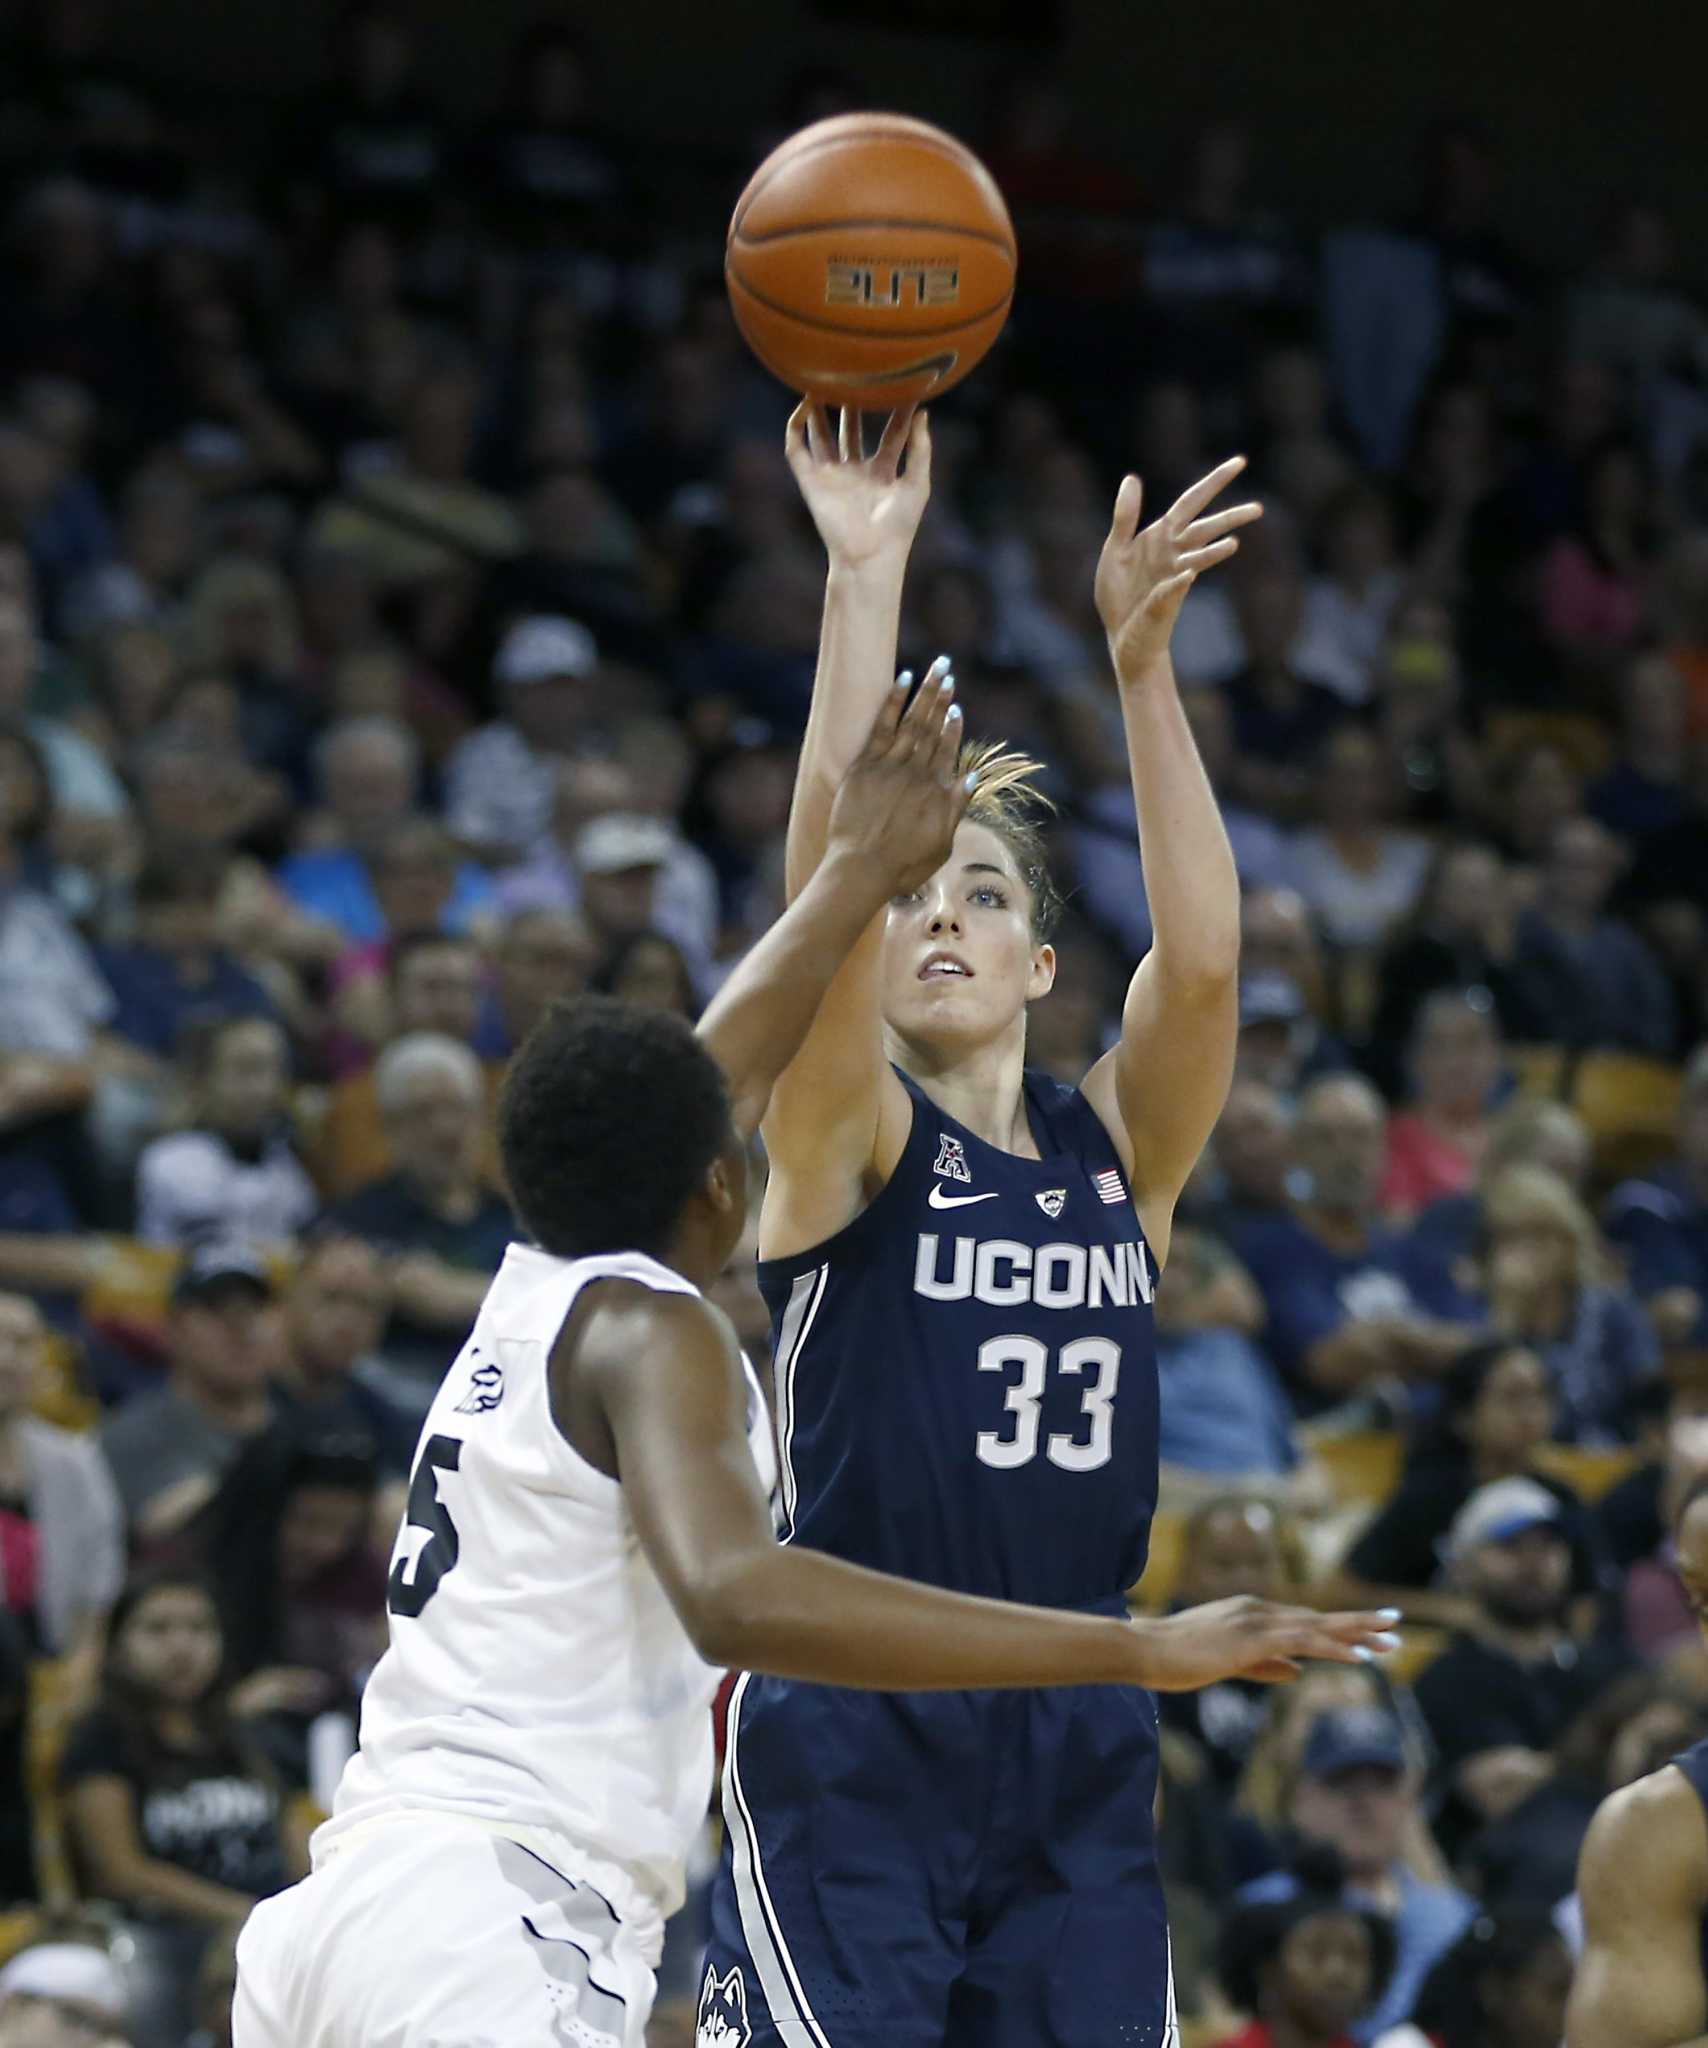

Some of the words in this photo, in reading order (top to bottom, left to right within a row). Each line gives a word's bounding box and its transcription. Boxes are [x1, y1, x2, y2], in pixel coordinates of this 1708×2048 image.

[913, 1233, 1155, 1309] UCONN
[976, 1334, 1122, 1473] 33
[387, 1434, 464, 1619] 5
